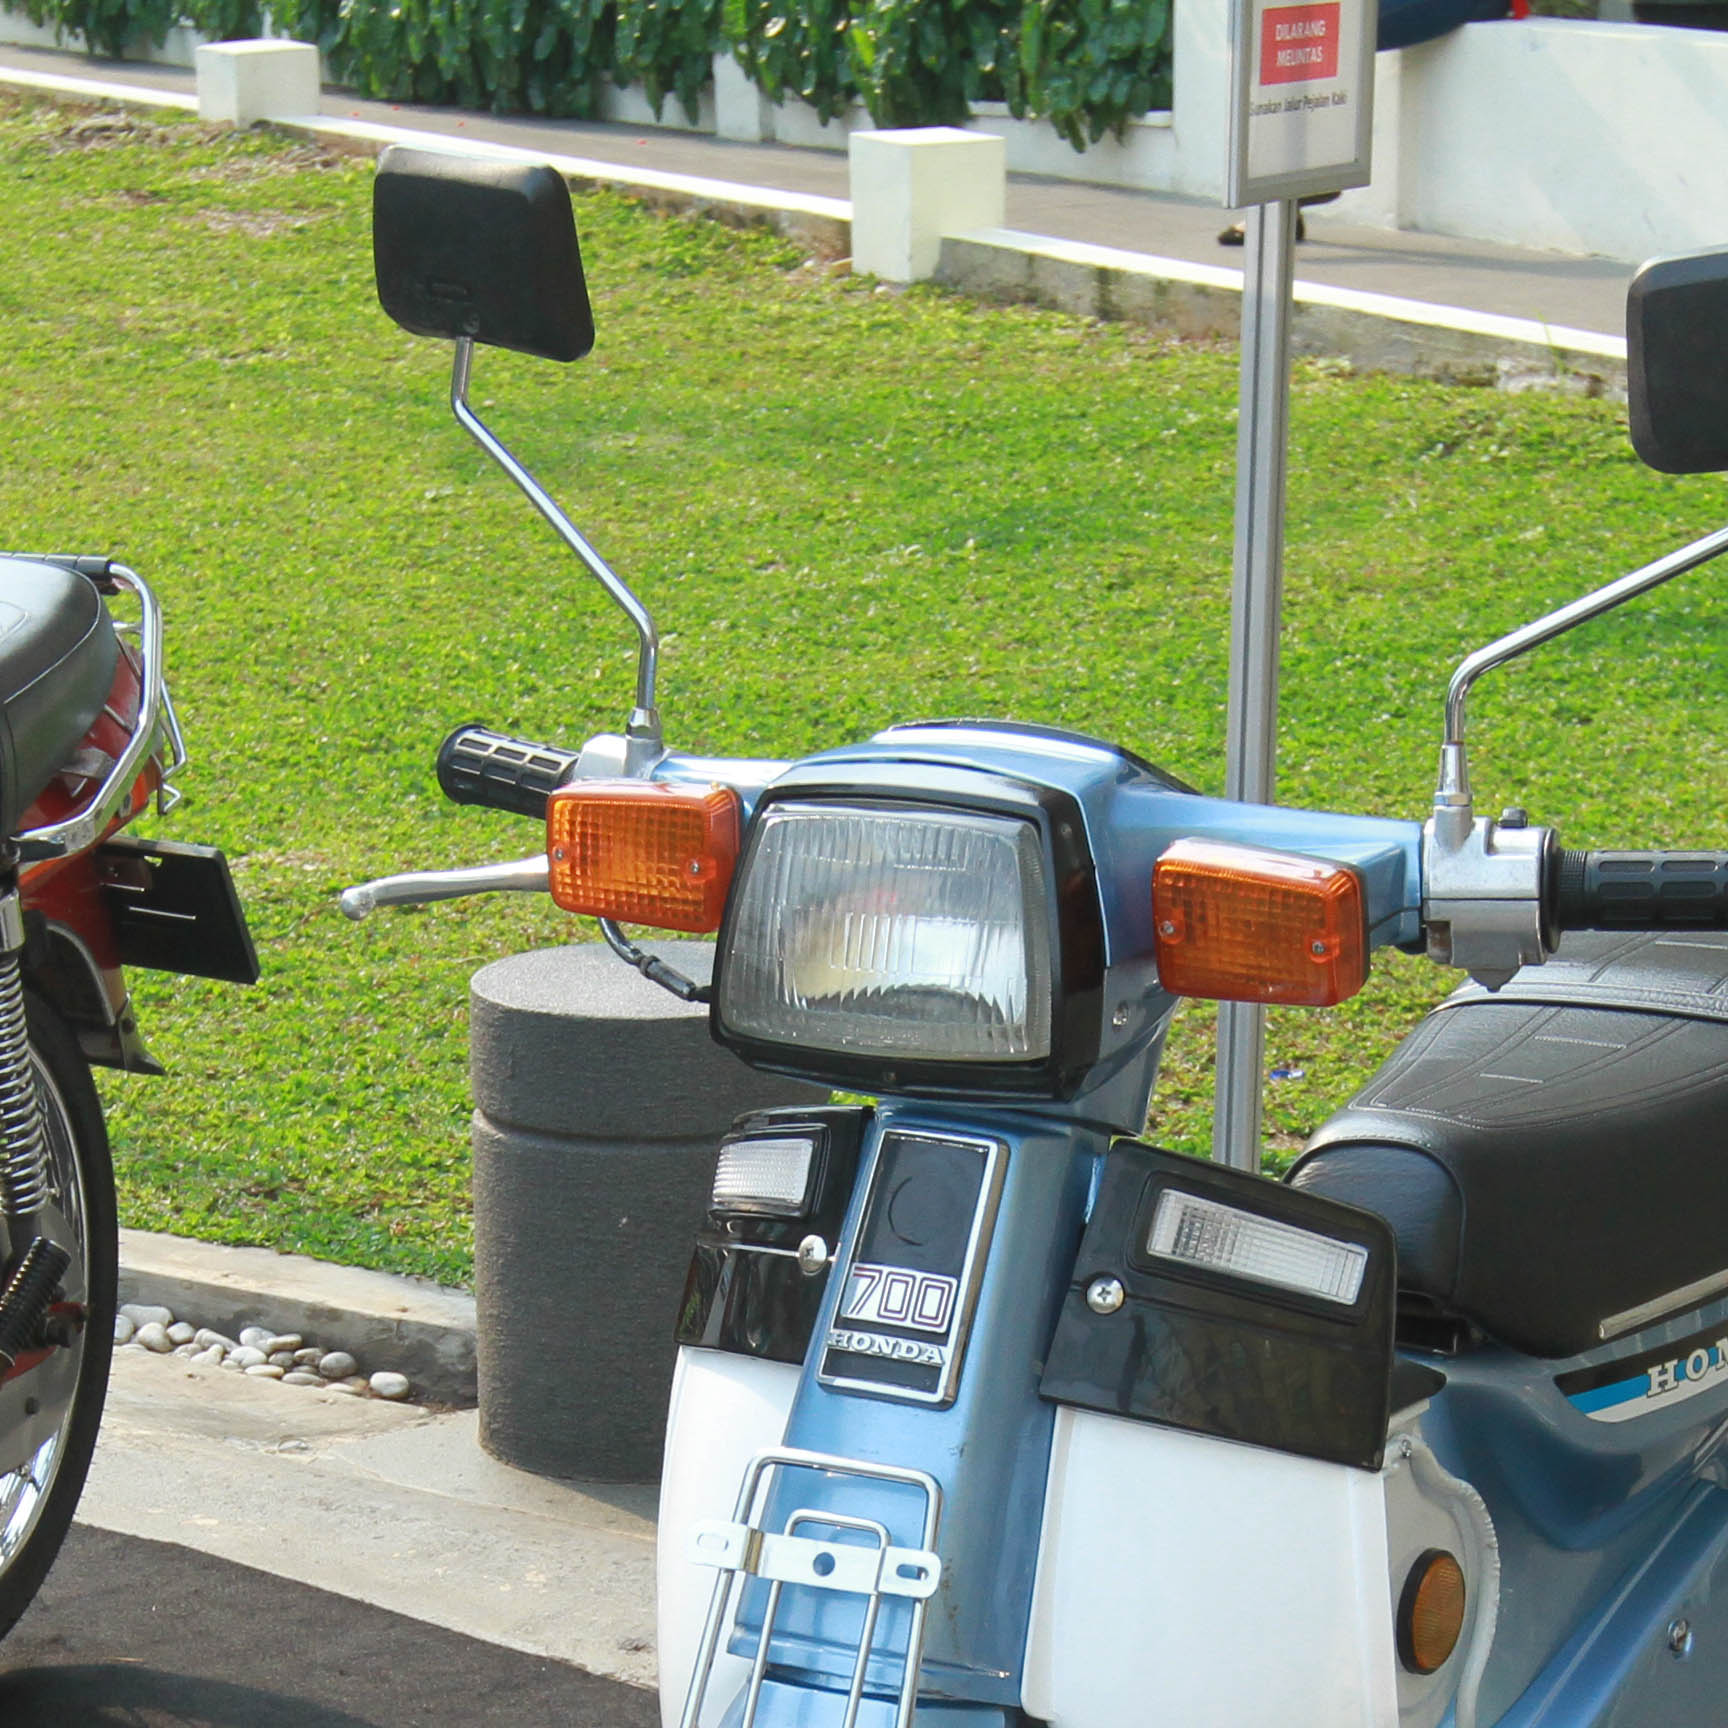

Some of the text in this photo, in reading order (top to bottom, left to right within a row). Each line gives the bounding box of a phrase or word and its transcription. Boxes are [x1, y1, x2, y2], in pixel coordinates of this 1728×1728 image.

[1275, 20, 1326, 41] DILARANG
[1276, 46, 1323, 67] MELINTAS
[844, 1265, 954, 1328] 700
[827, 1332, 945, 1367] HONDA
